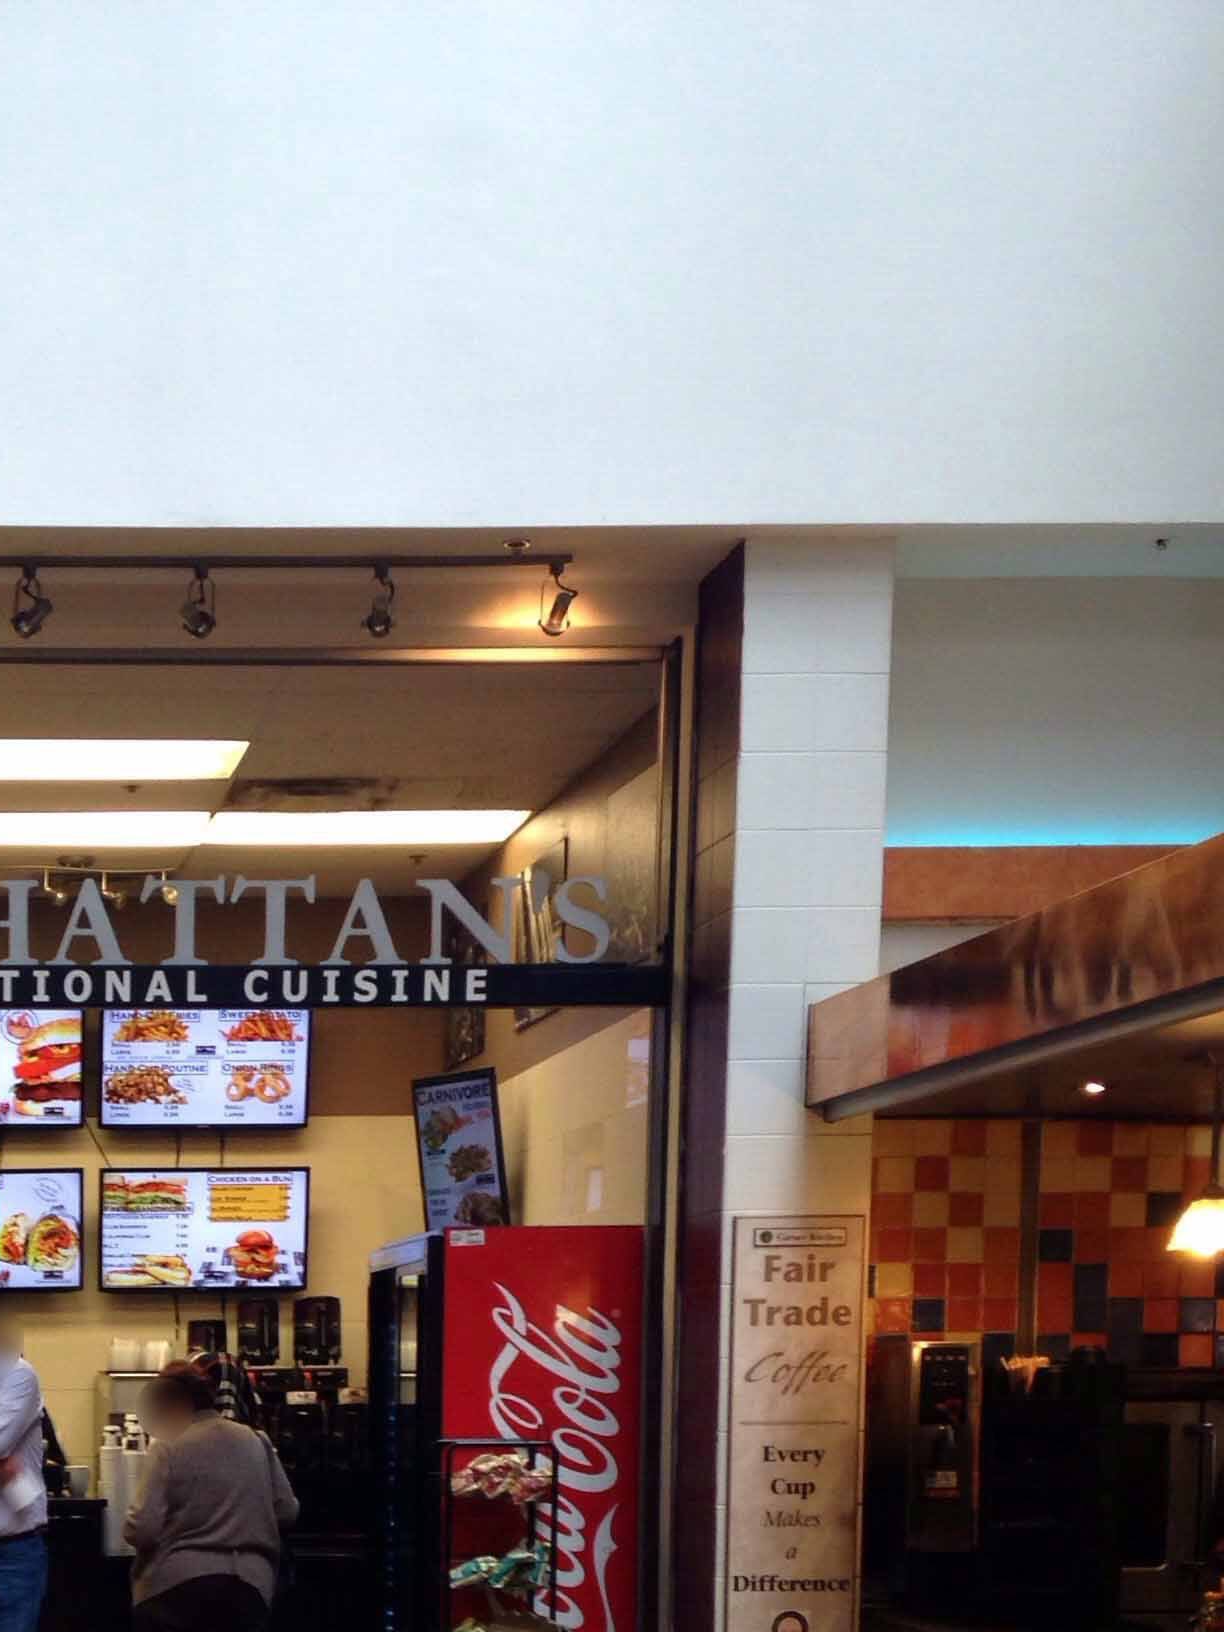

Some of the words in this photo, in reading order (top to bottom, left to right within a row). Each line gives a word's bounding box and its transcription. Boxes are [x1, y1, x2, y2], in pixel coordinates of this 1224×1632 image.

[243, 968, 490, 1004] CUISINE
[763, 1254, 836, 1283] Fair
[743, 1298, 852, 1328] Trade
[743, 1350, 850, 1397] Coffee
[762, 1445, 825, 1466] Every
[770, 1478, 816, 1500] Cup
[761, 1510, 822, 1528] Makes
[785, 1546, 798, 1561] a
[733, 1574, 851, 1593] Difference
